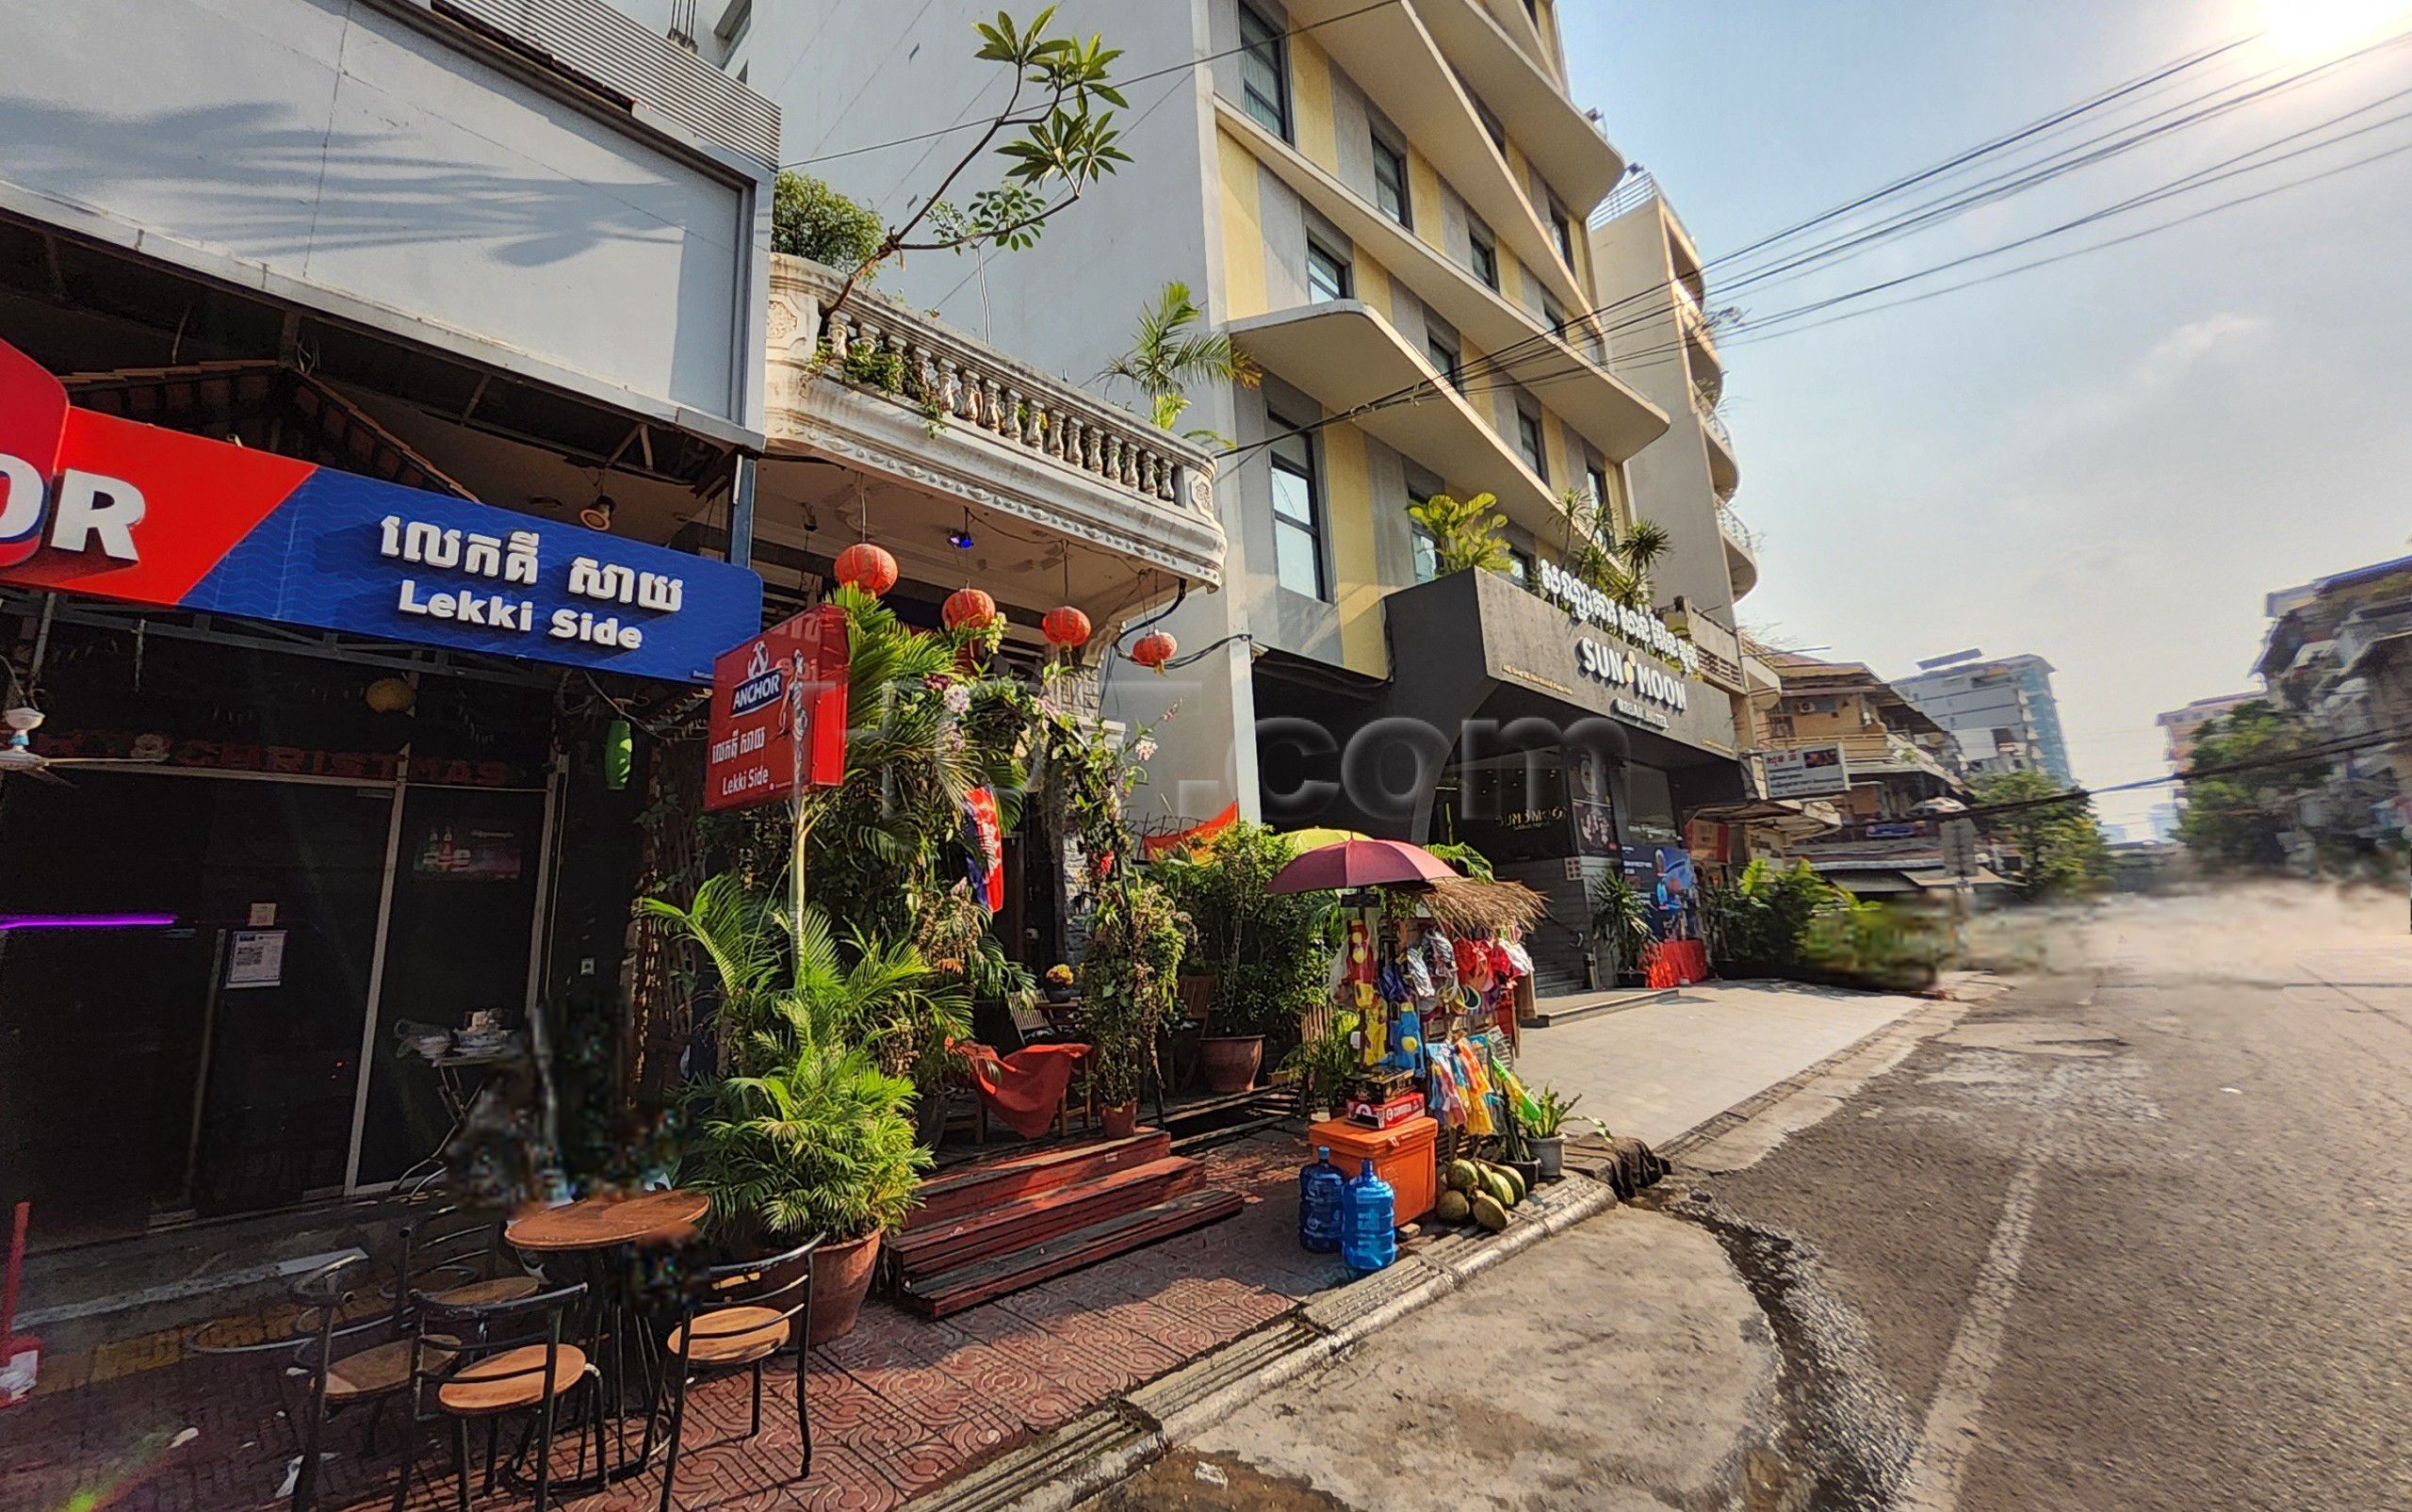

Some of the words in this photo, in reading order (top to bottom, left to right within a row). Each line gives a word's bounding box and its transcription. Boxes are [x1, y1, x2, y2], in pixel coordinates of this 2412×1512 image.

[380, 515, 540, 585] លេកគី
[567, 556, 684, 612] សាយ
[398, 579, 535, 632] Lekki
[547, 609, 644, 650] Side
[732, 673, 781, 710] ANCHOR
[1580, 636, 1626, 685] SUN
[1636, 662, 1688, 711] MOON
[722, 769, 747, 796] Lekki
[747, 765, 770, 788] Side
